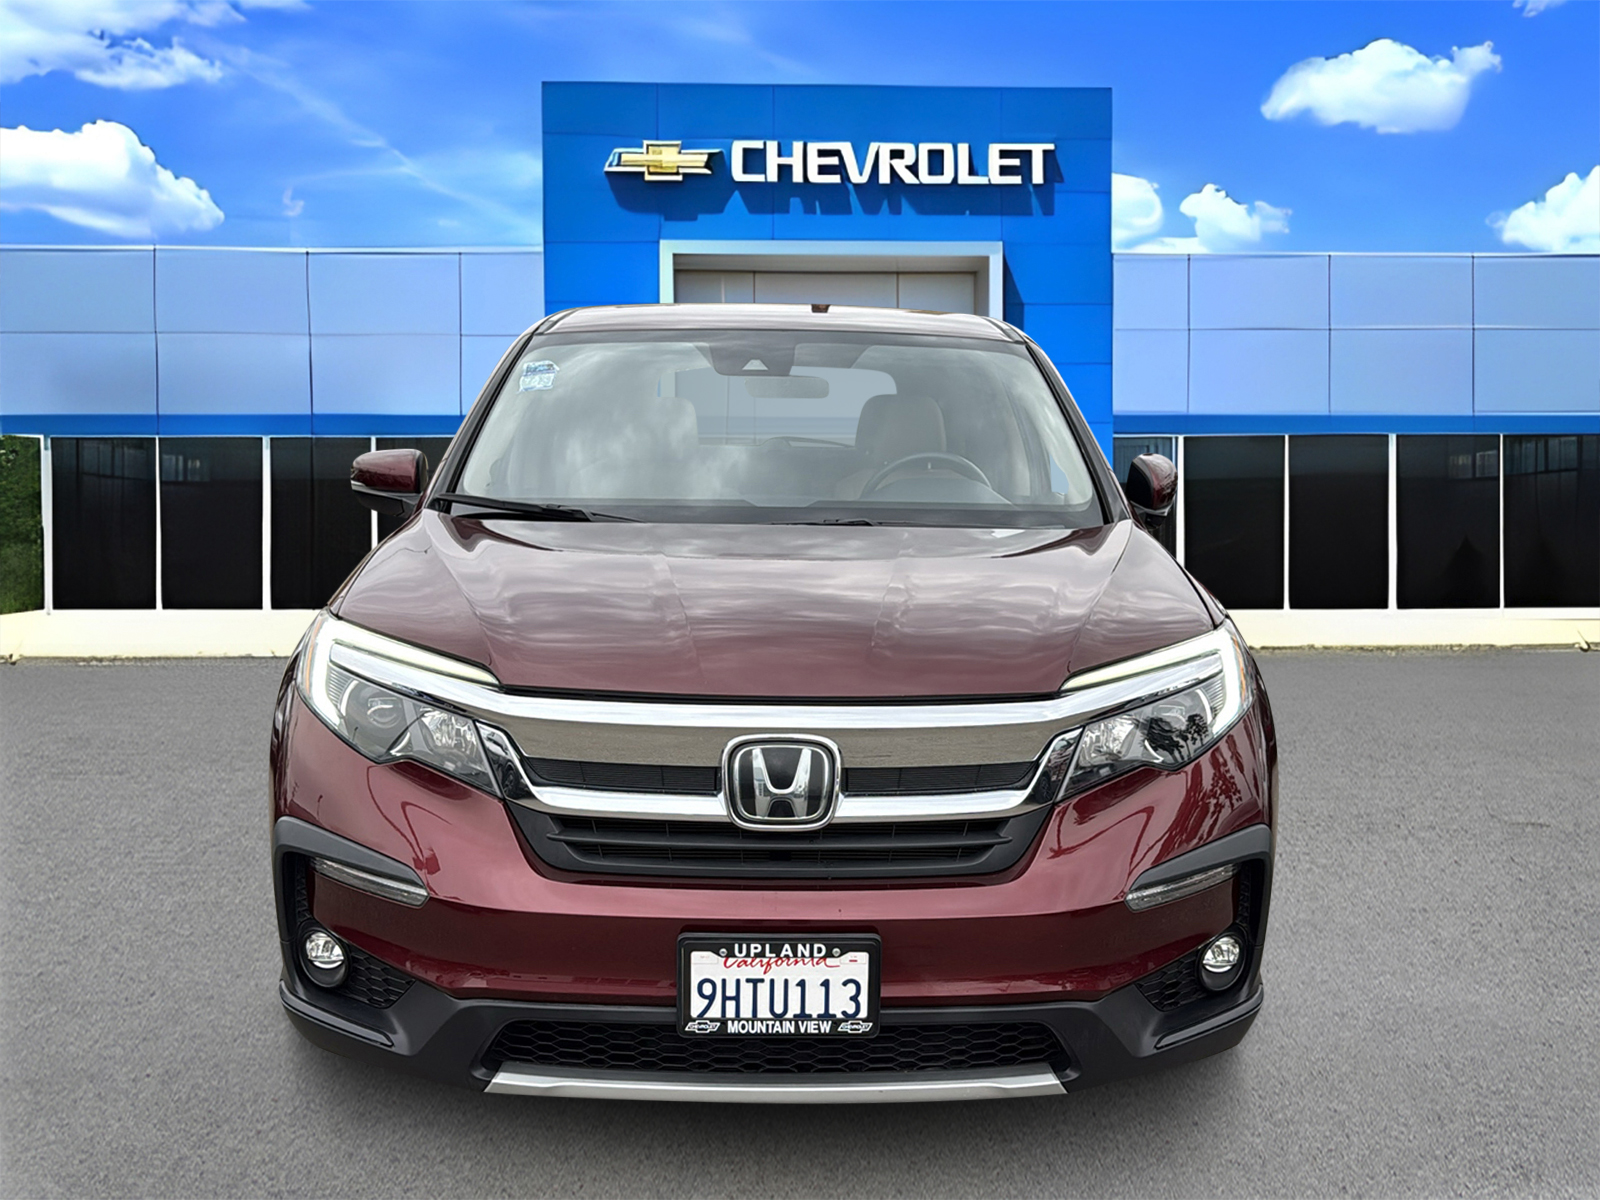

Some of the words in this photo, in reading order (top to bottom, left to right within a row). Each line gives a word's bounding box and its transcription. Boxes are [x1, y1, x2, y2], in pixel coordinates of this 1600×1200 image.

[731, 140, 1055, 184] CHEVROLET
[734, 943, 826, 957] UPLAND
[696, 978, 862, 1018] 9HTU113
[727, 1020, 795, 1033] MOUNTAIN
[798, 1020, 832, 1033] VIEW
